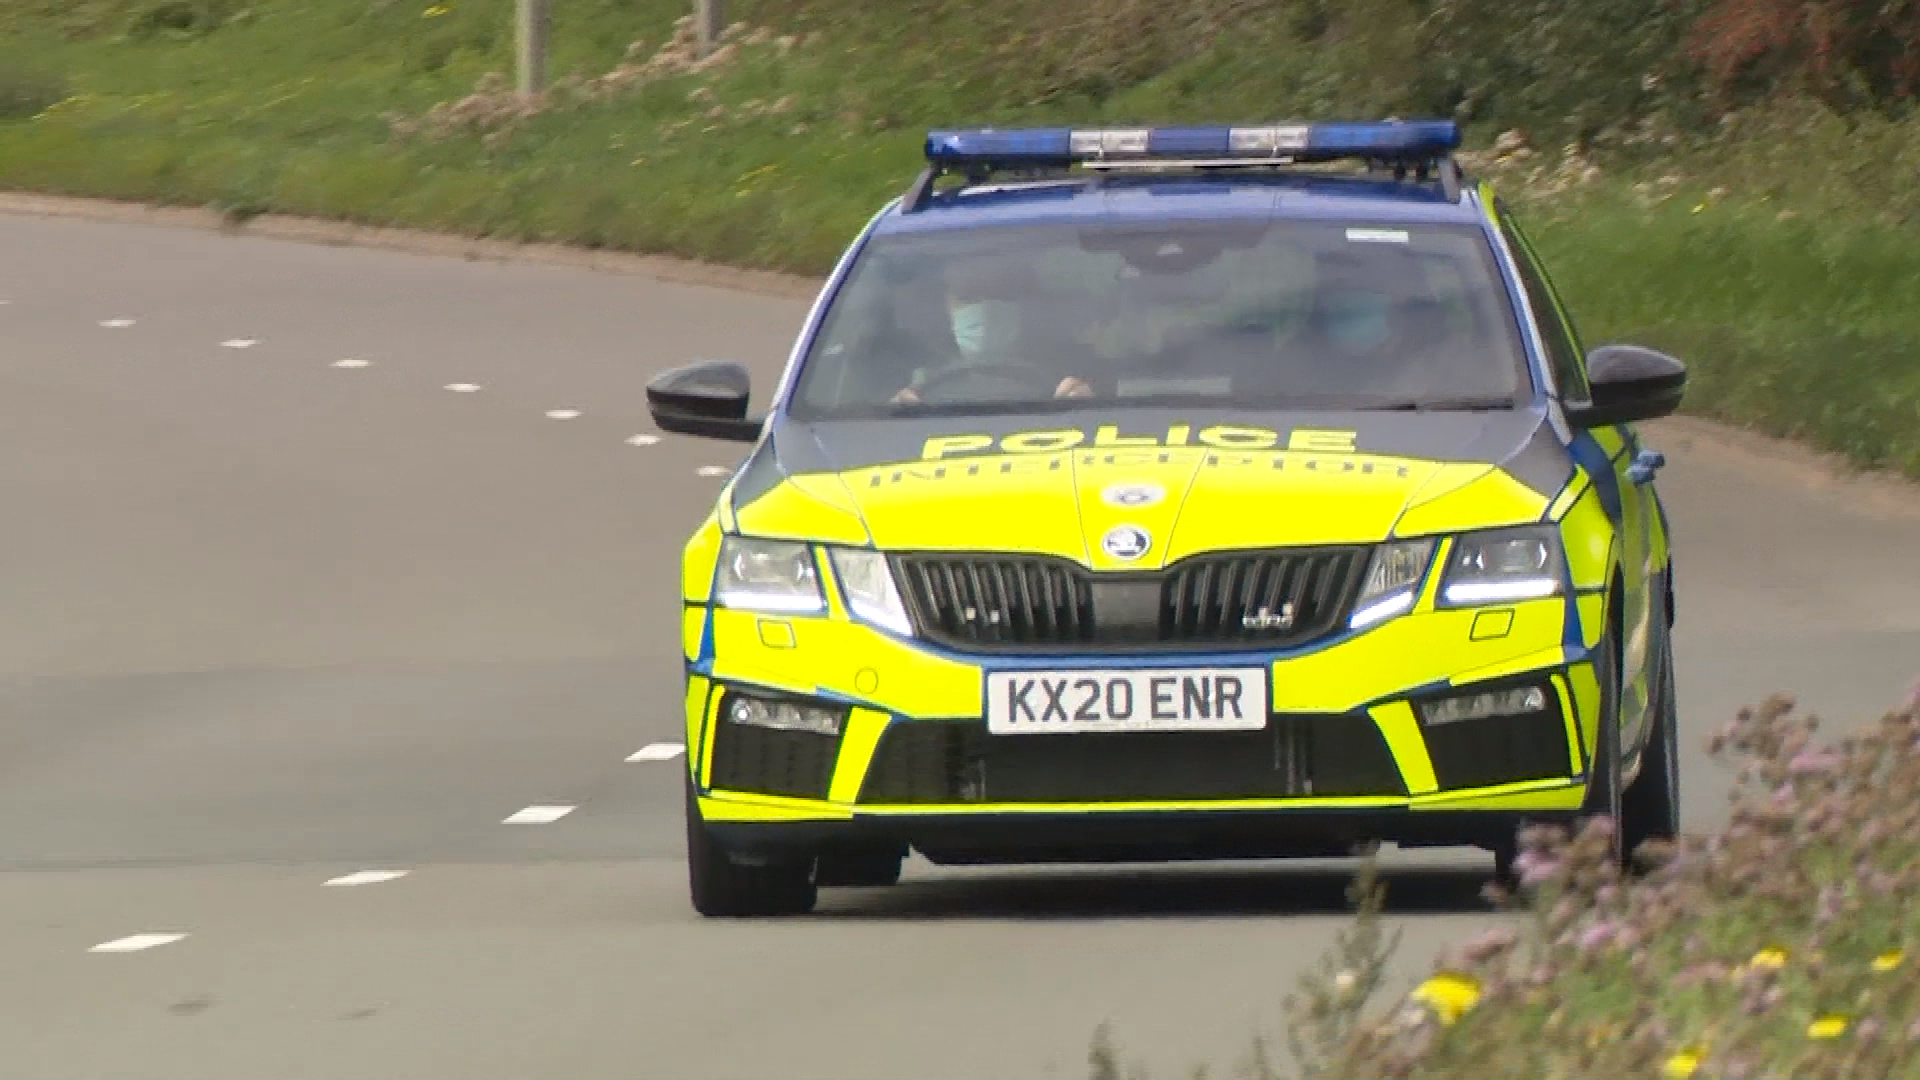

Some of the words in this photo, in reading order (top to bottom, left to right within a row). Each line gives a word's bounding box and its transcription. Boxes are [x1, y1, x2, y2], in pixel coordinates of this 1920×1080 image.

[921, 424, 1358, 460] POLICE
[1008, 677, 1134, 723] KX20
[1149, 675, 1243, 719] ENR
